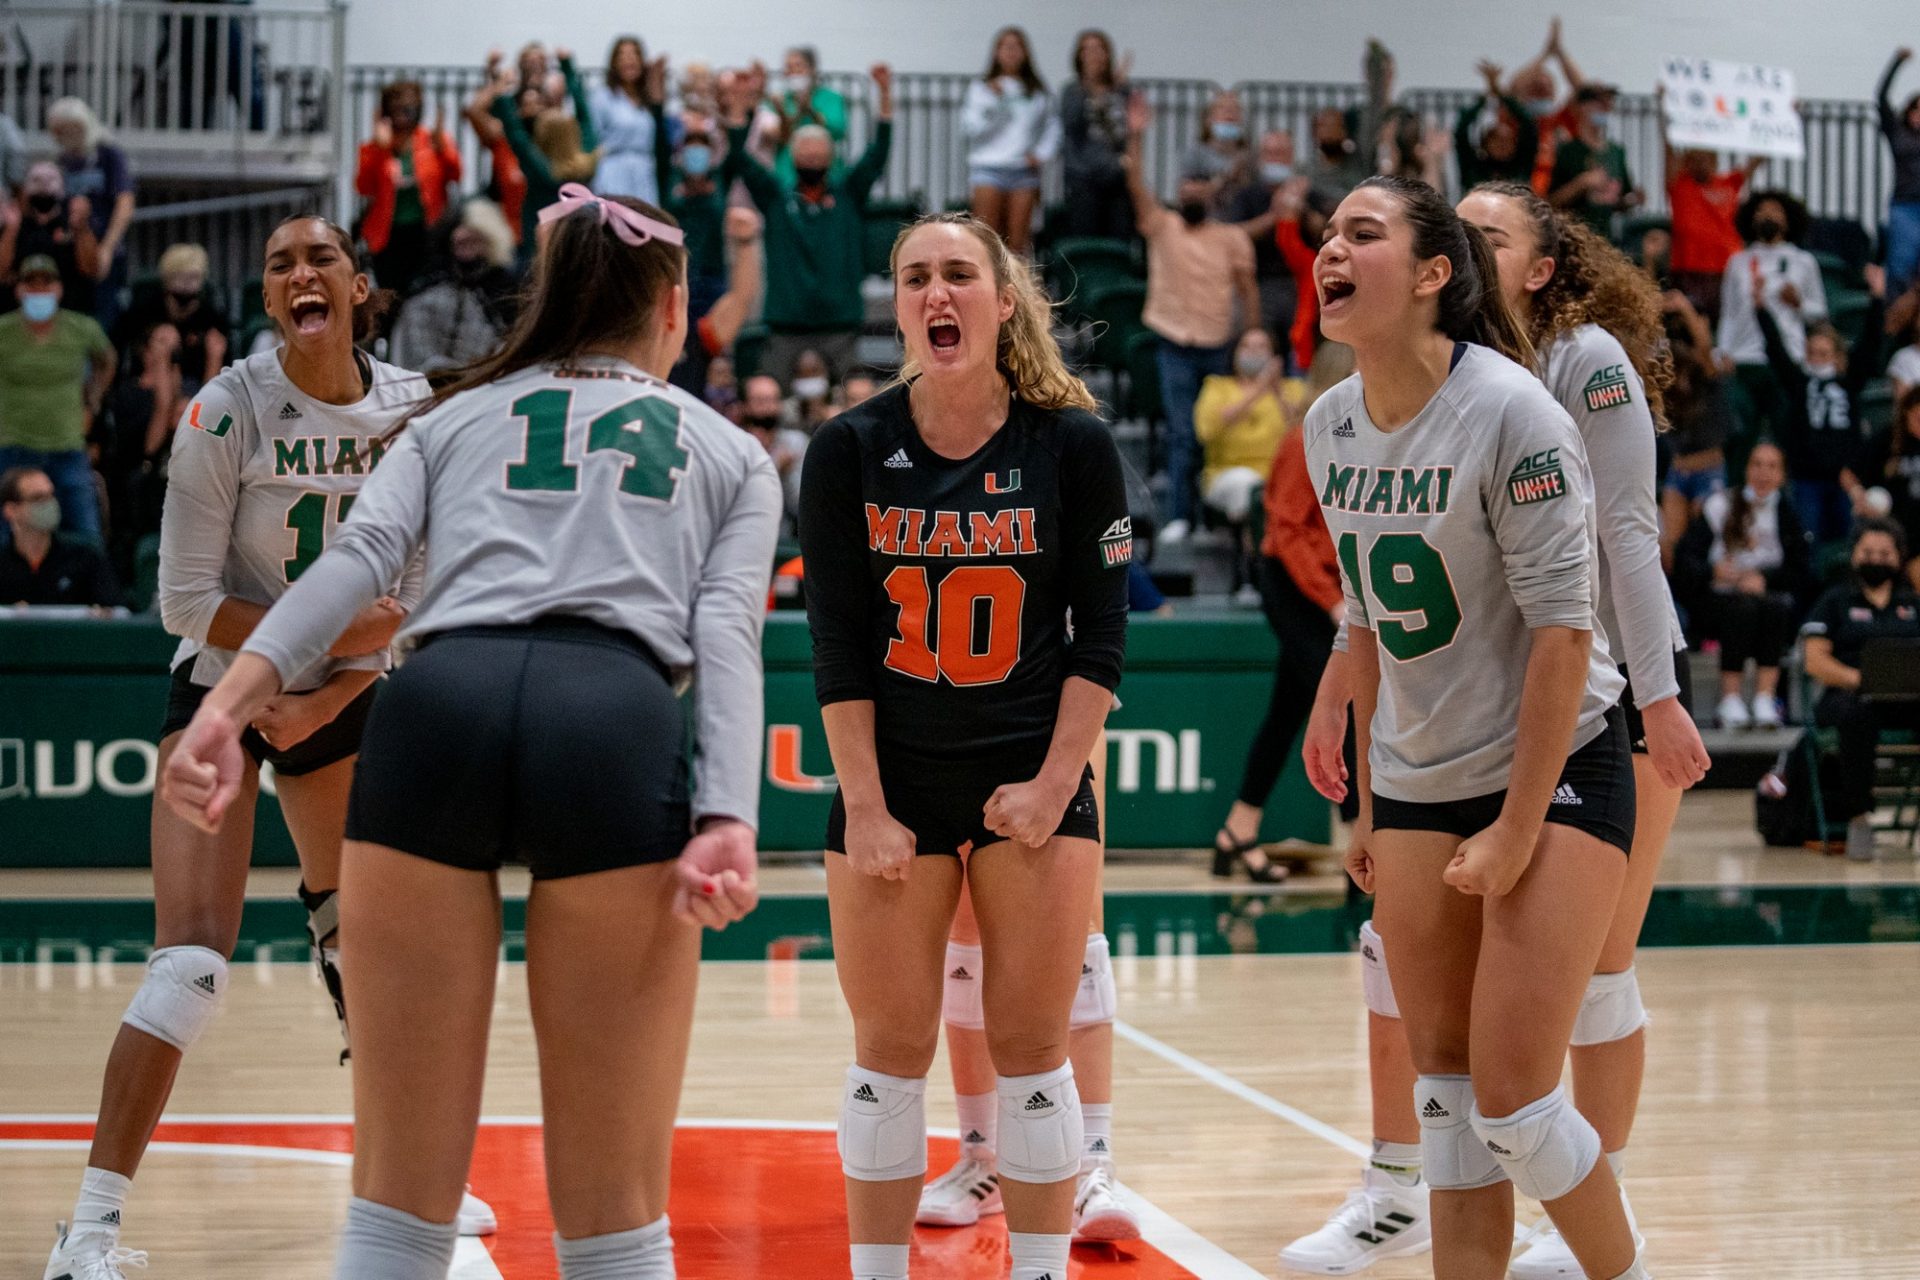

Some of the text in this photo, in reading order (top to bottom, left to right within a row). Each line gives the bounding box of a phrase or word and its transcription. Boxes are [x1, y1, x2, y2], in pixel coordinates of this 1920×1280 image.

[1587, 364, 1626, 387] ACC
[1588, 383, 1629, 410] UNITE
[502, 384, 693, 506] 14
[883, 460, 913, 468] adidas
[1512, 447, 1561, 475] ACC
[984, 468, 1021, 494] U
[1321, 459, 1455, 516] MIAMI
[1511, 471, 1564, 504] UNITE
[864, 501, 1039, 558] MIAMI
[1337, 530, 1465, 664] 19
[882, 565, 1027, 688] 10
[853, 1092, 879, 1104] adidas
[1024, 1100, 1055, 1111] adidas
[1422, 1109, 1450, 1118] adidas
